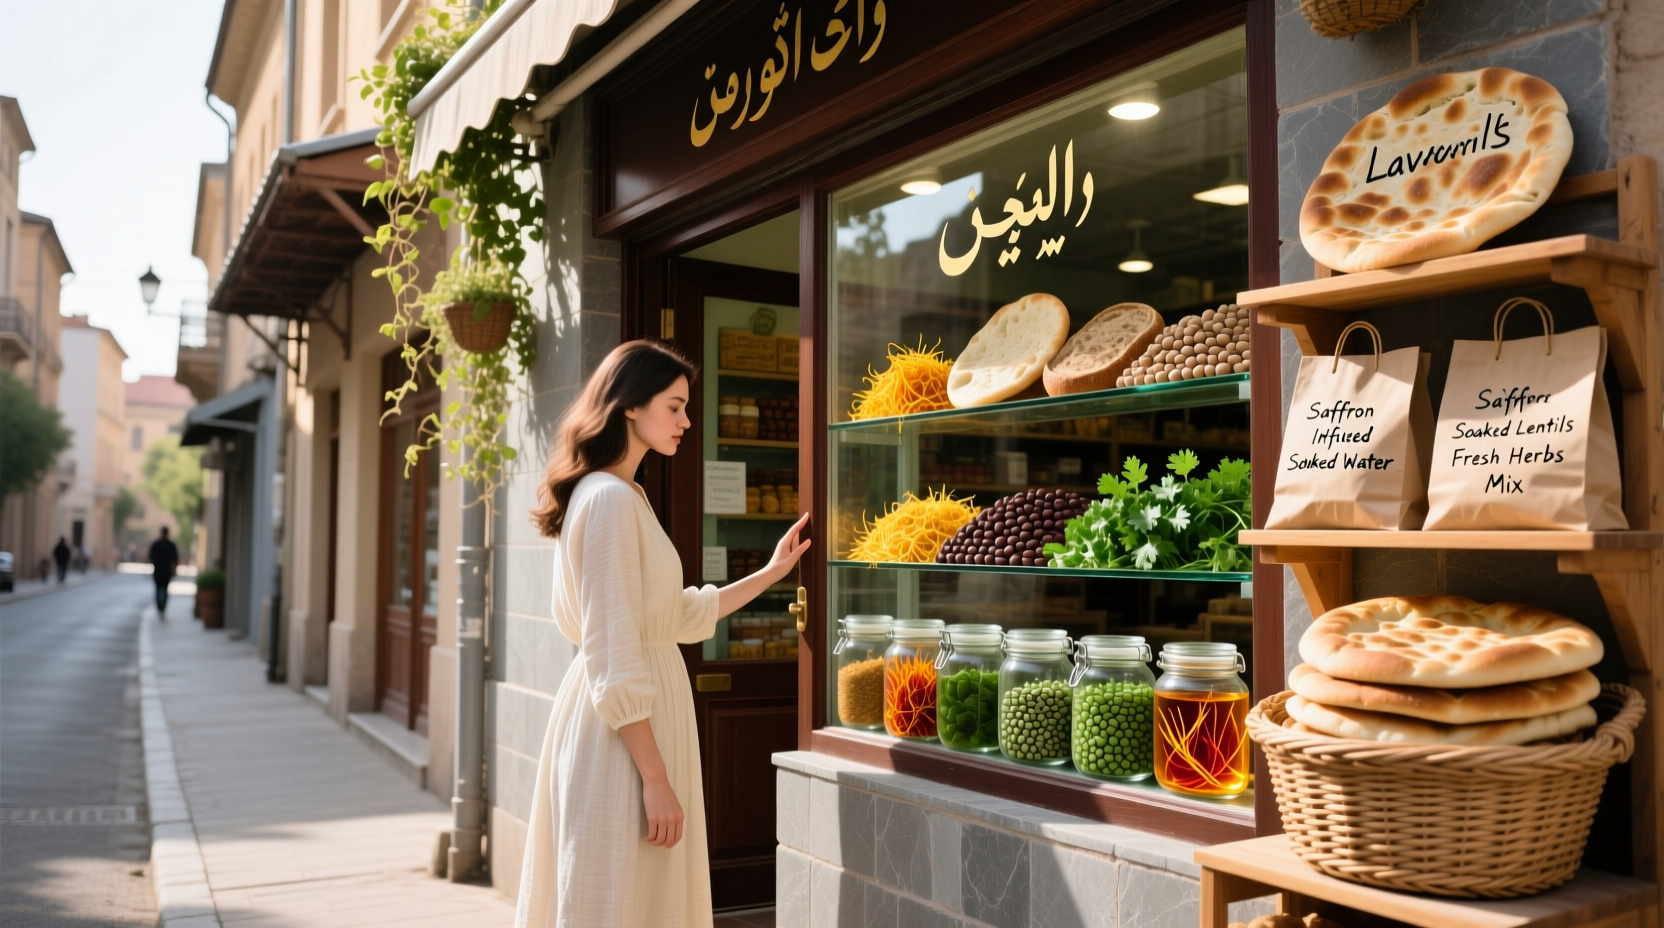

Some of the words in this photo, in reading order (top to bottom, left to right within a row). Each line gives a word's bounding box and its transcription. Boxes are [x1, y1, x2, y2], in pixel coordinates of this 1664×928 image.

[1307, 400, 1374, 424] Saffron
[1452, 419, 1512, 439] Soaked
[1516, 415, 1574, 436] Lentils
[1344, 453, 1395, 471] Water
[1452, 448, 1500, 467] Fresh
[1509, 444, 1564, 464] Herbs
[1485, 474, 1524, 494] Mix
